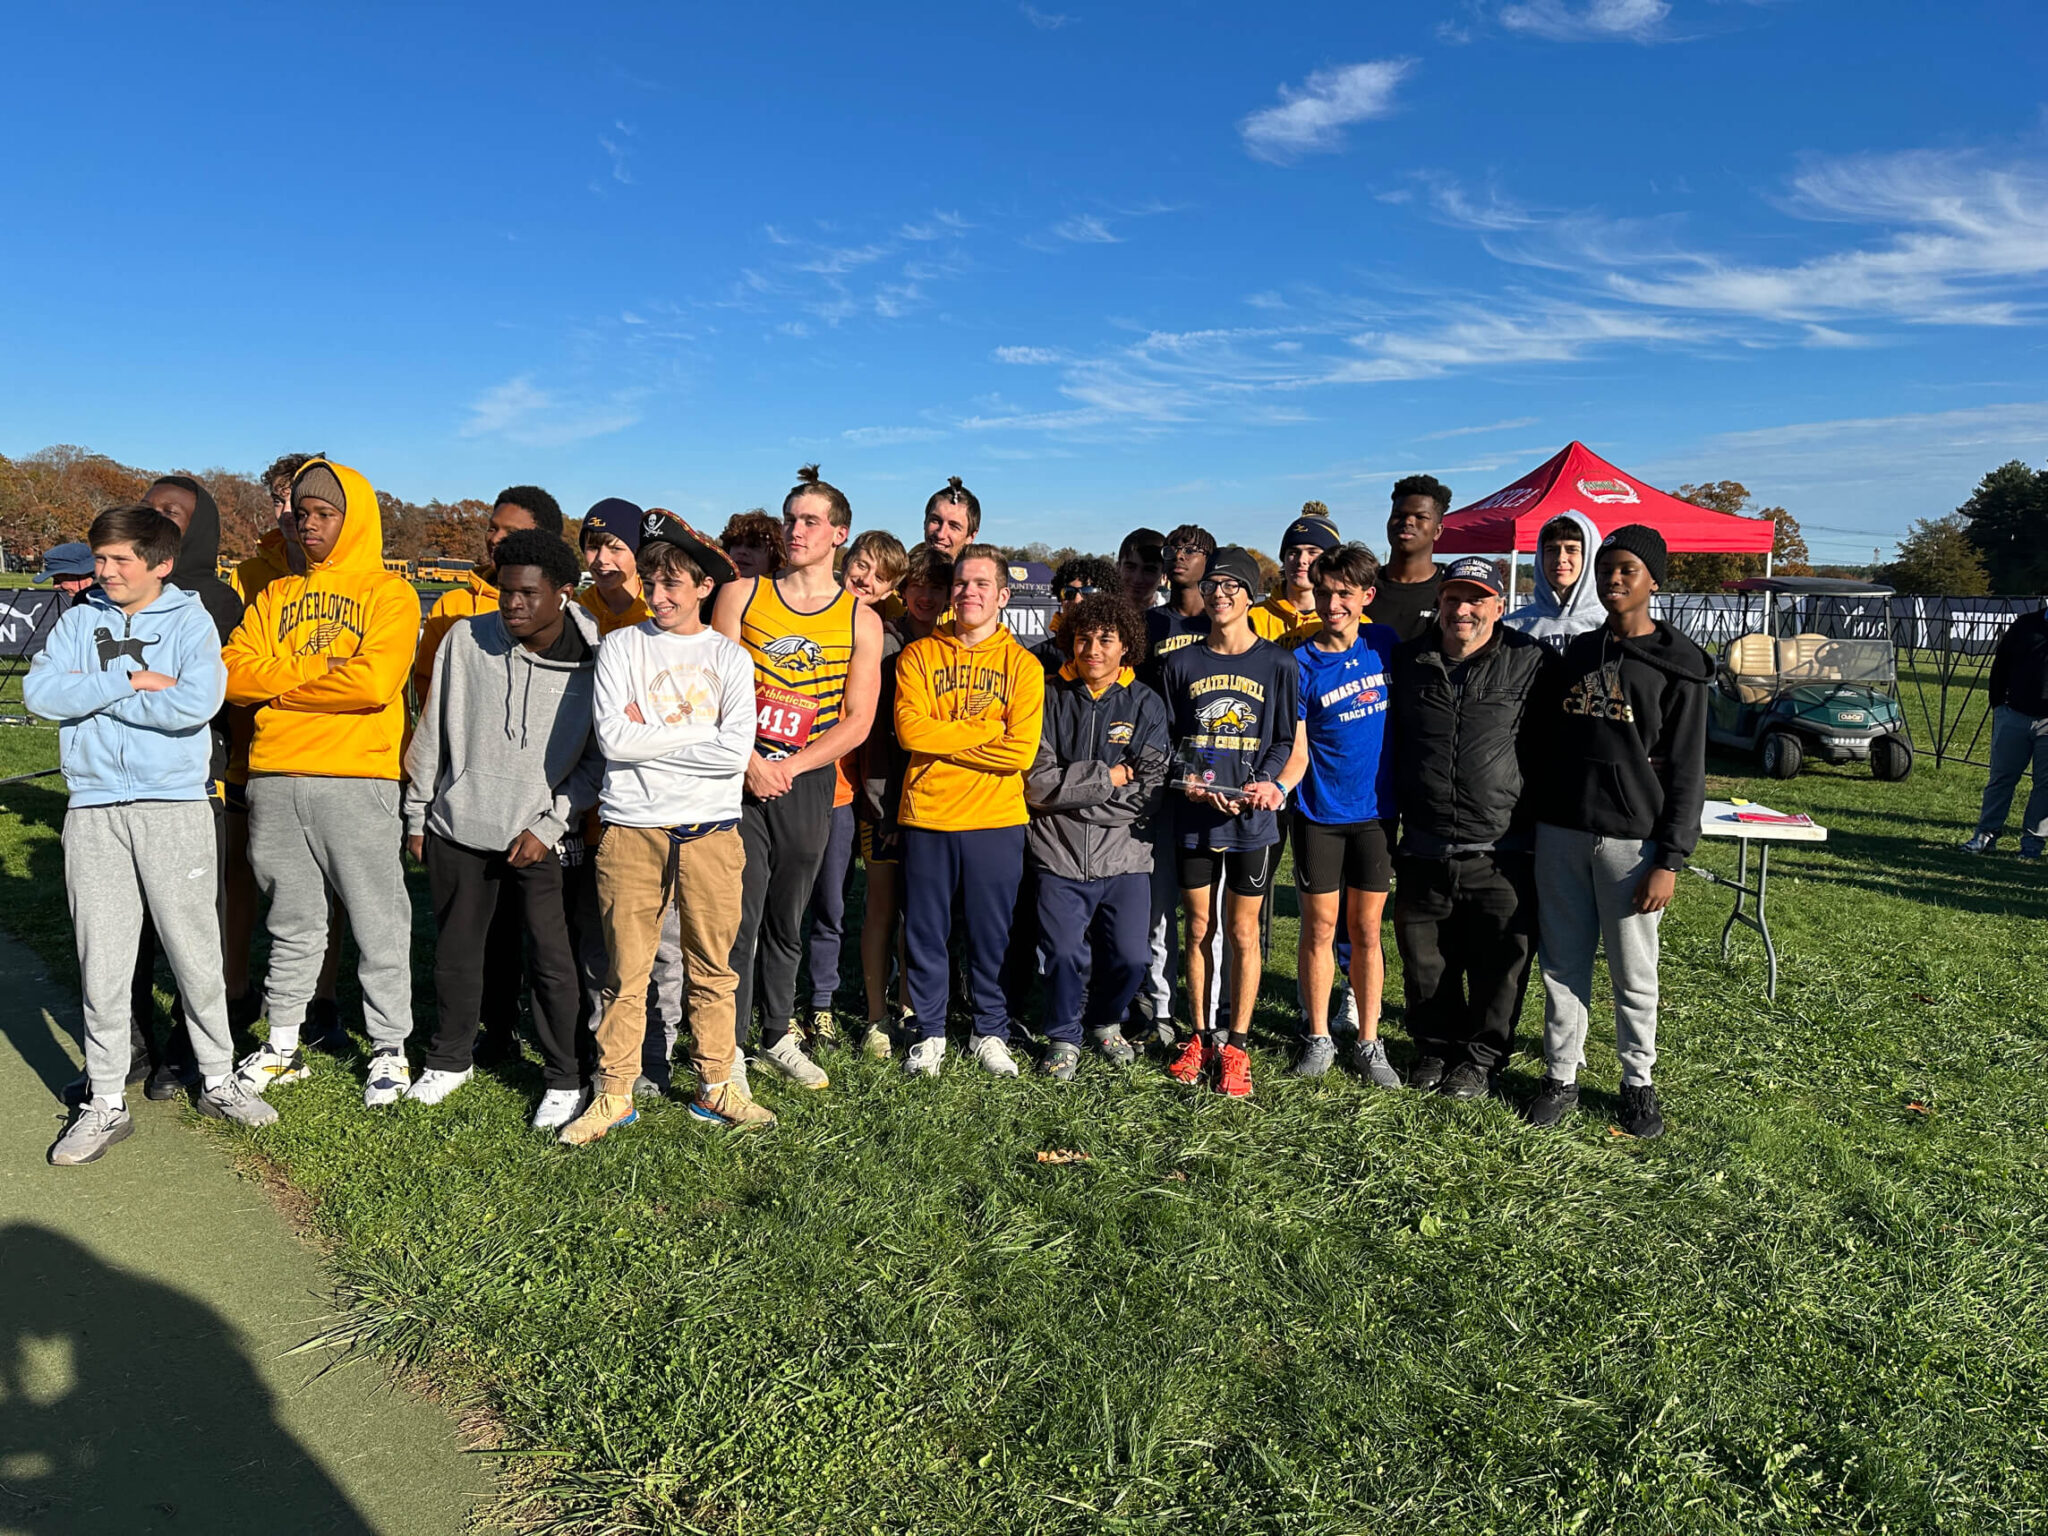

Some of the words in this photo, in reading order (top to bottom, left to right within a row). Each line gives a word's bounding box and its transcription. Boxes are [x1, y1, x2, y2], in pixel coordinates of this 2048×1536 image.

[1009, 583, 1034, 591] OUNTY
[1189, 674, 1229, 699] GREATER
[1229, 674, 1265, 703] LOWELL
[1321, 680, 1361, 708] UMASS
[1360, 673, 1393, 690] LOWEL
[757, 705, 801, 738] 413
[1338, 706, 1367, 723] TRACK
